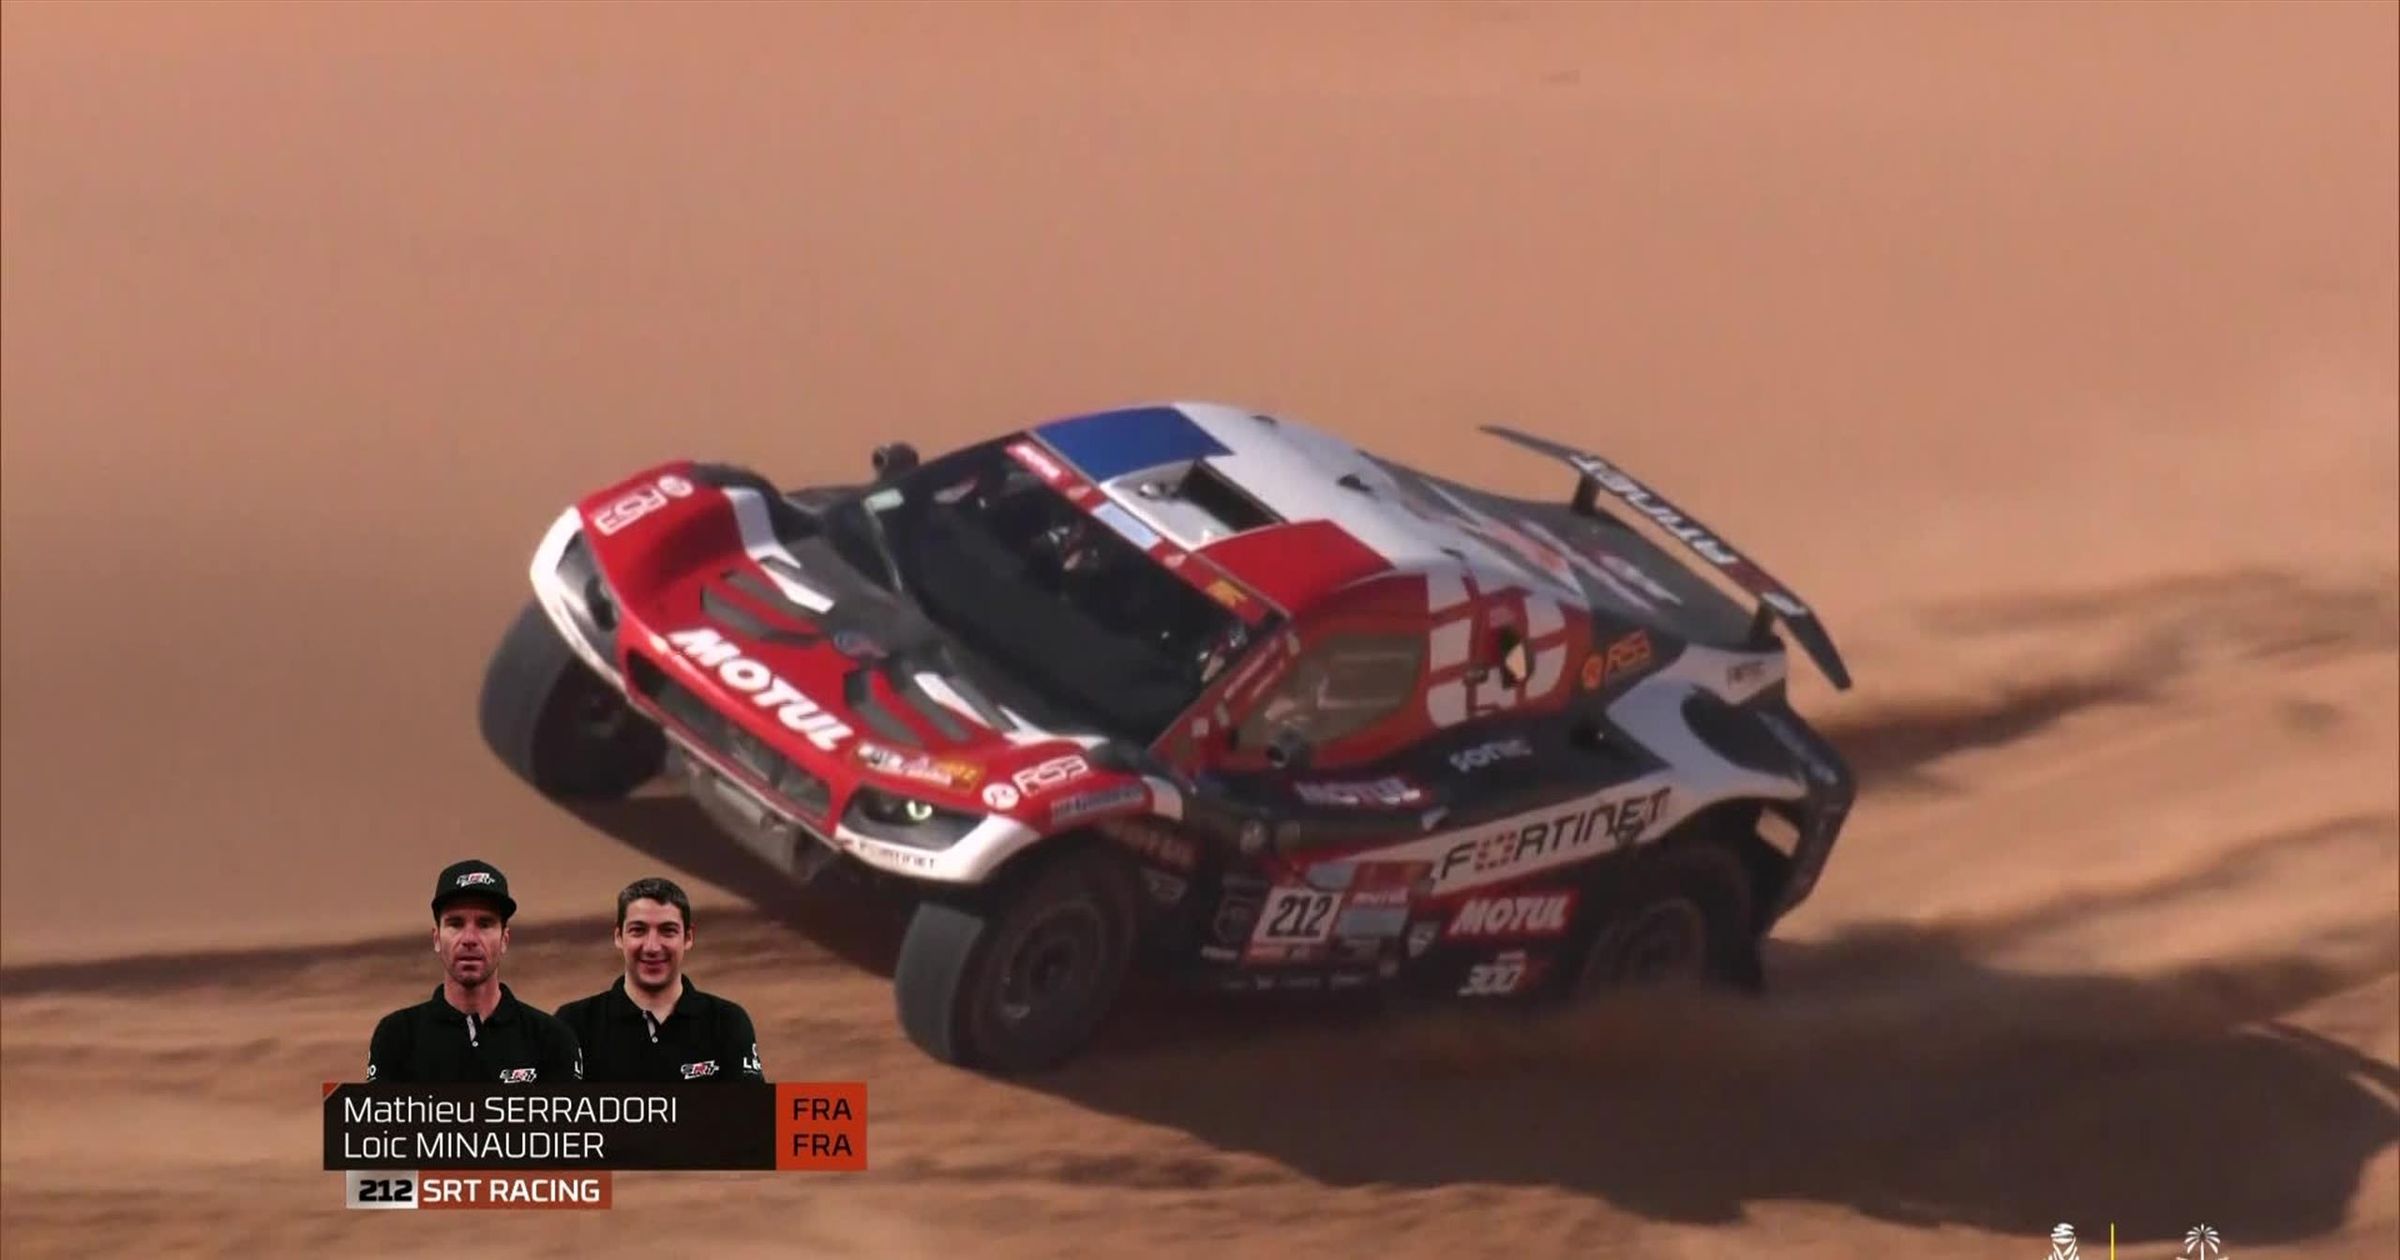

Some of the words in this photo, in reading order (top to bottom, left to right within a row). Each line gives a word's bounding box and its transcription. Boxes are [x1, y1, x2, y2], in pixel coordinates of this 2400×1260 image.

[665, 627, 855, 751] MOTUL
[1440, 786, 1671, 880] FORTINET
[1266, 895, 1332, 938] 212
[1449, 895, 1569, 936] MOTUL
